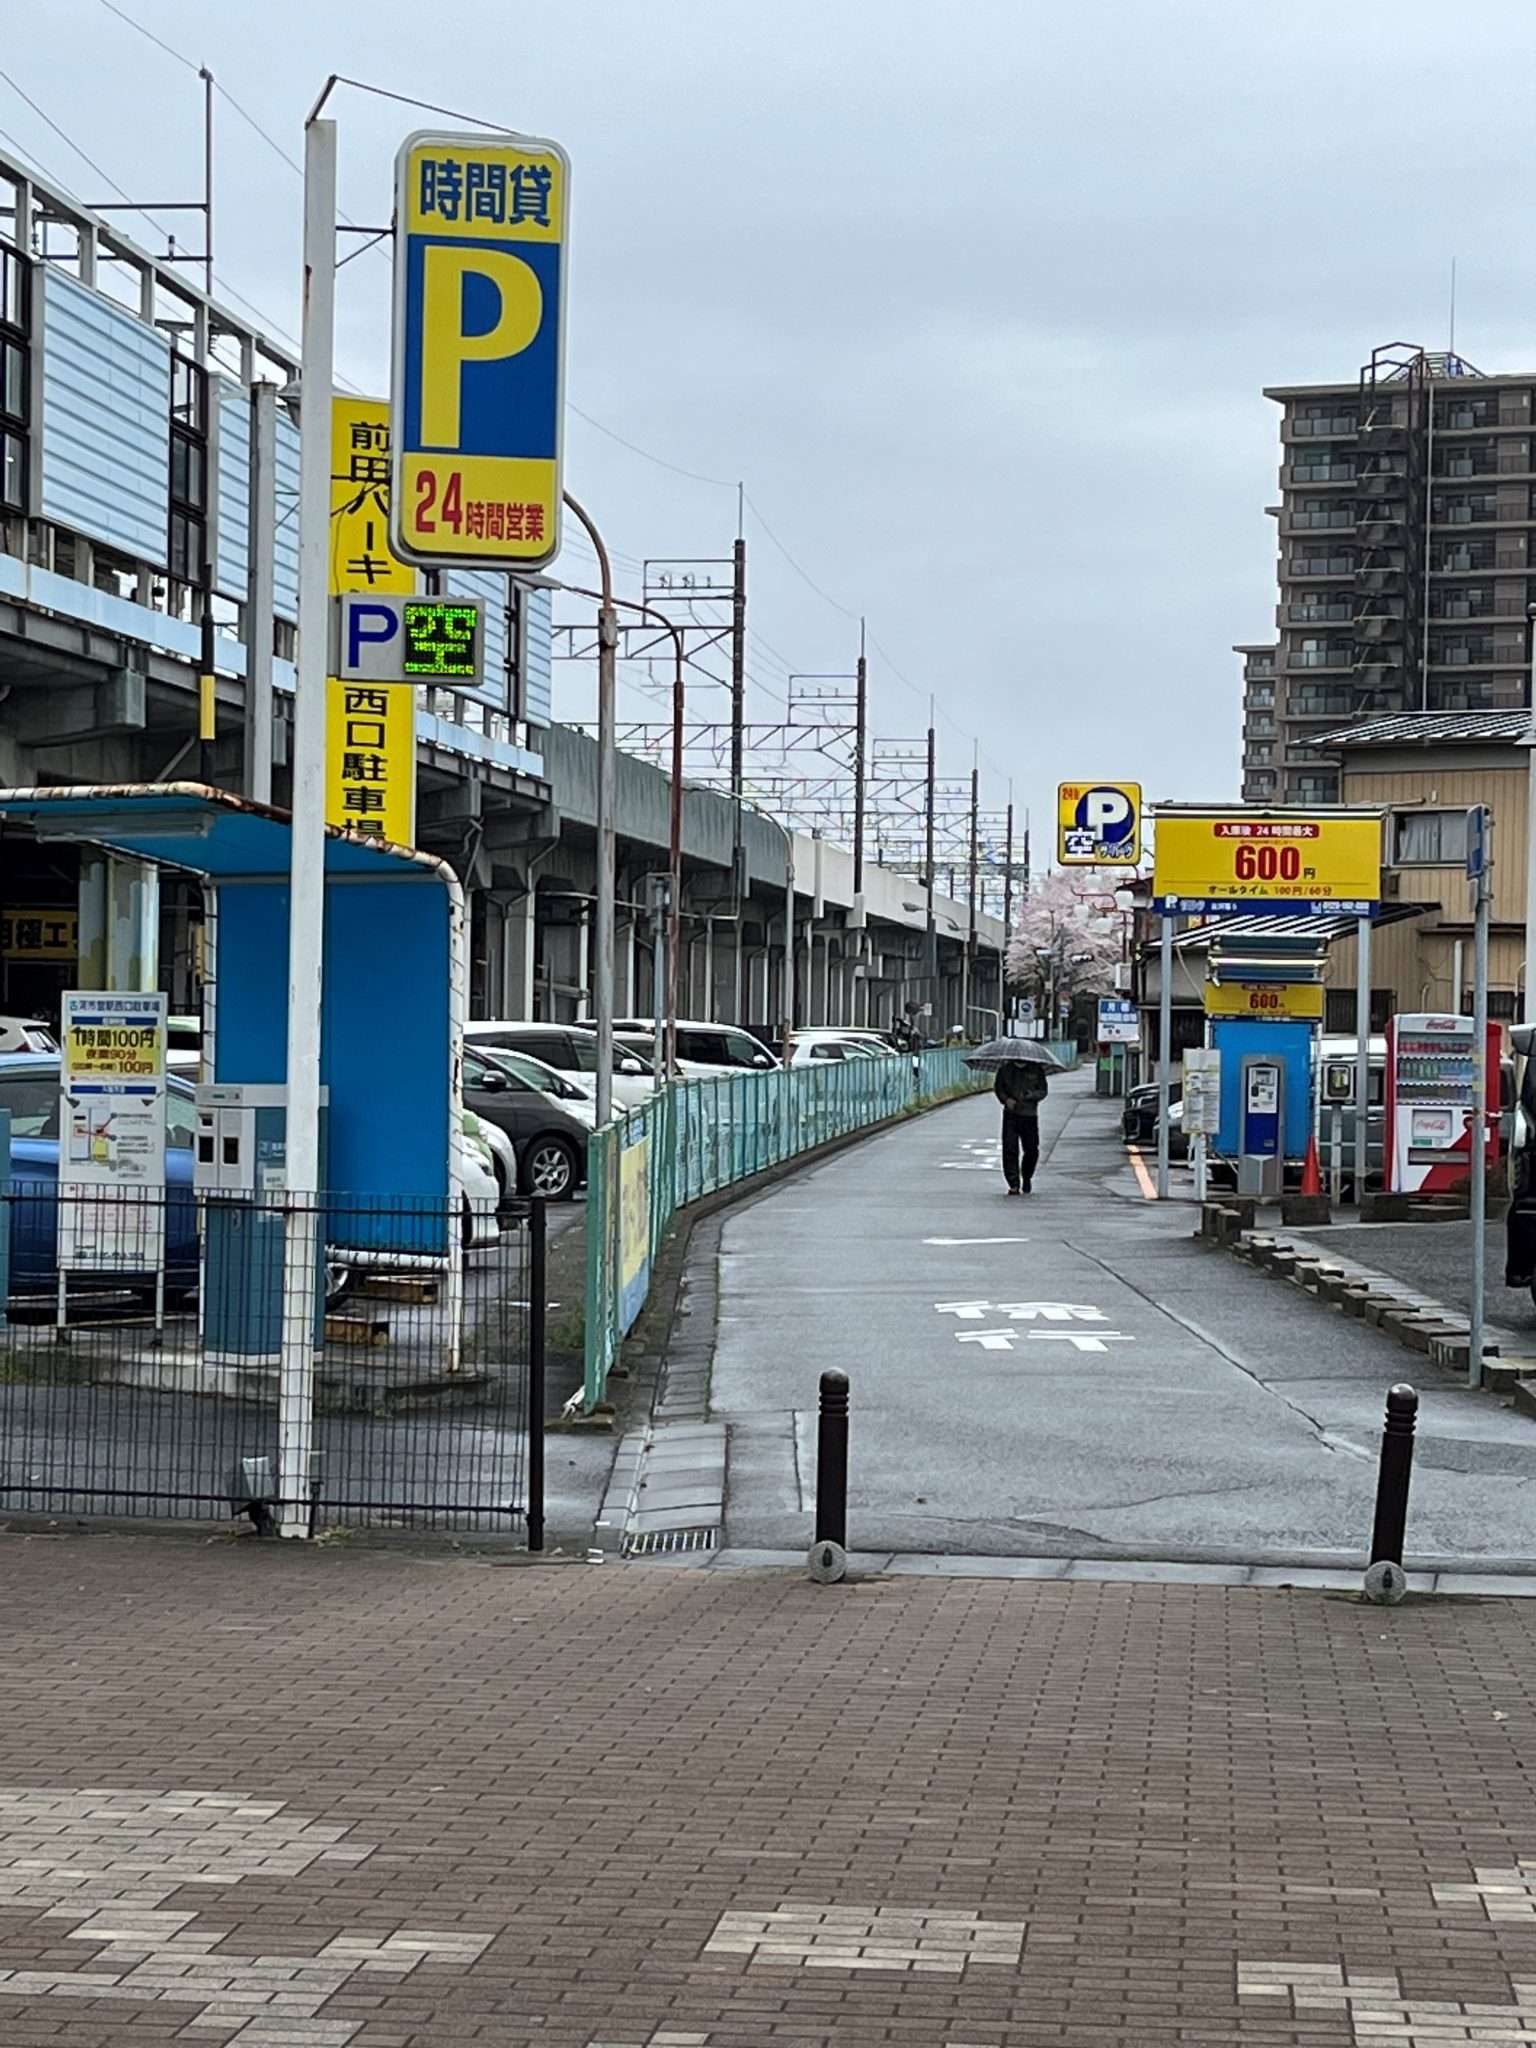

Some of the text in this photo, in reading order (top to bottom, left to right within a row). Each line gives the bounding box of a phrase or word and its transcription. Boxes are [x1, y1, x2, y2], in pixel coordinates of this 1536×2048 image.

[420, 159, 552, 228] 時間貸
[420, 245, 543, 449] P
[346, 421, 392, 593] 前田パーキ
[415, 470, 545, 542] 24時間営業
[348, 603, 399, 669] P
[404, 602, 478, 676] 空
[1065, 827, 1096, 858] 空
[1087, 791, 1129, 841] P
[1235, 845, 1316, 881] 600 円
[1249, 993, 1279, 1010] 600
